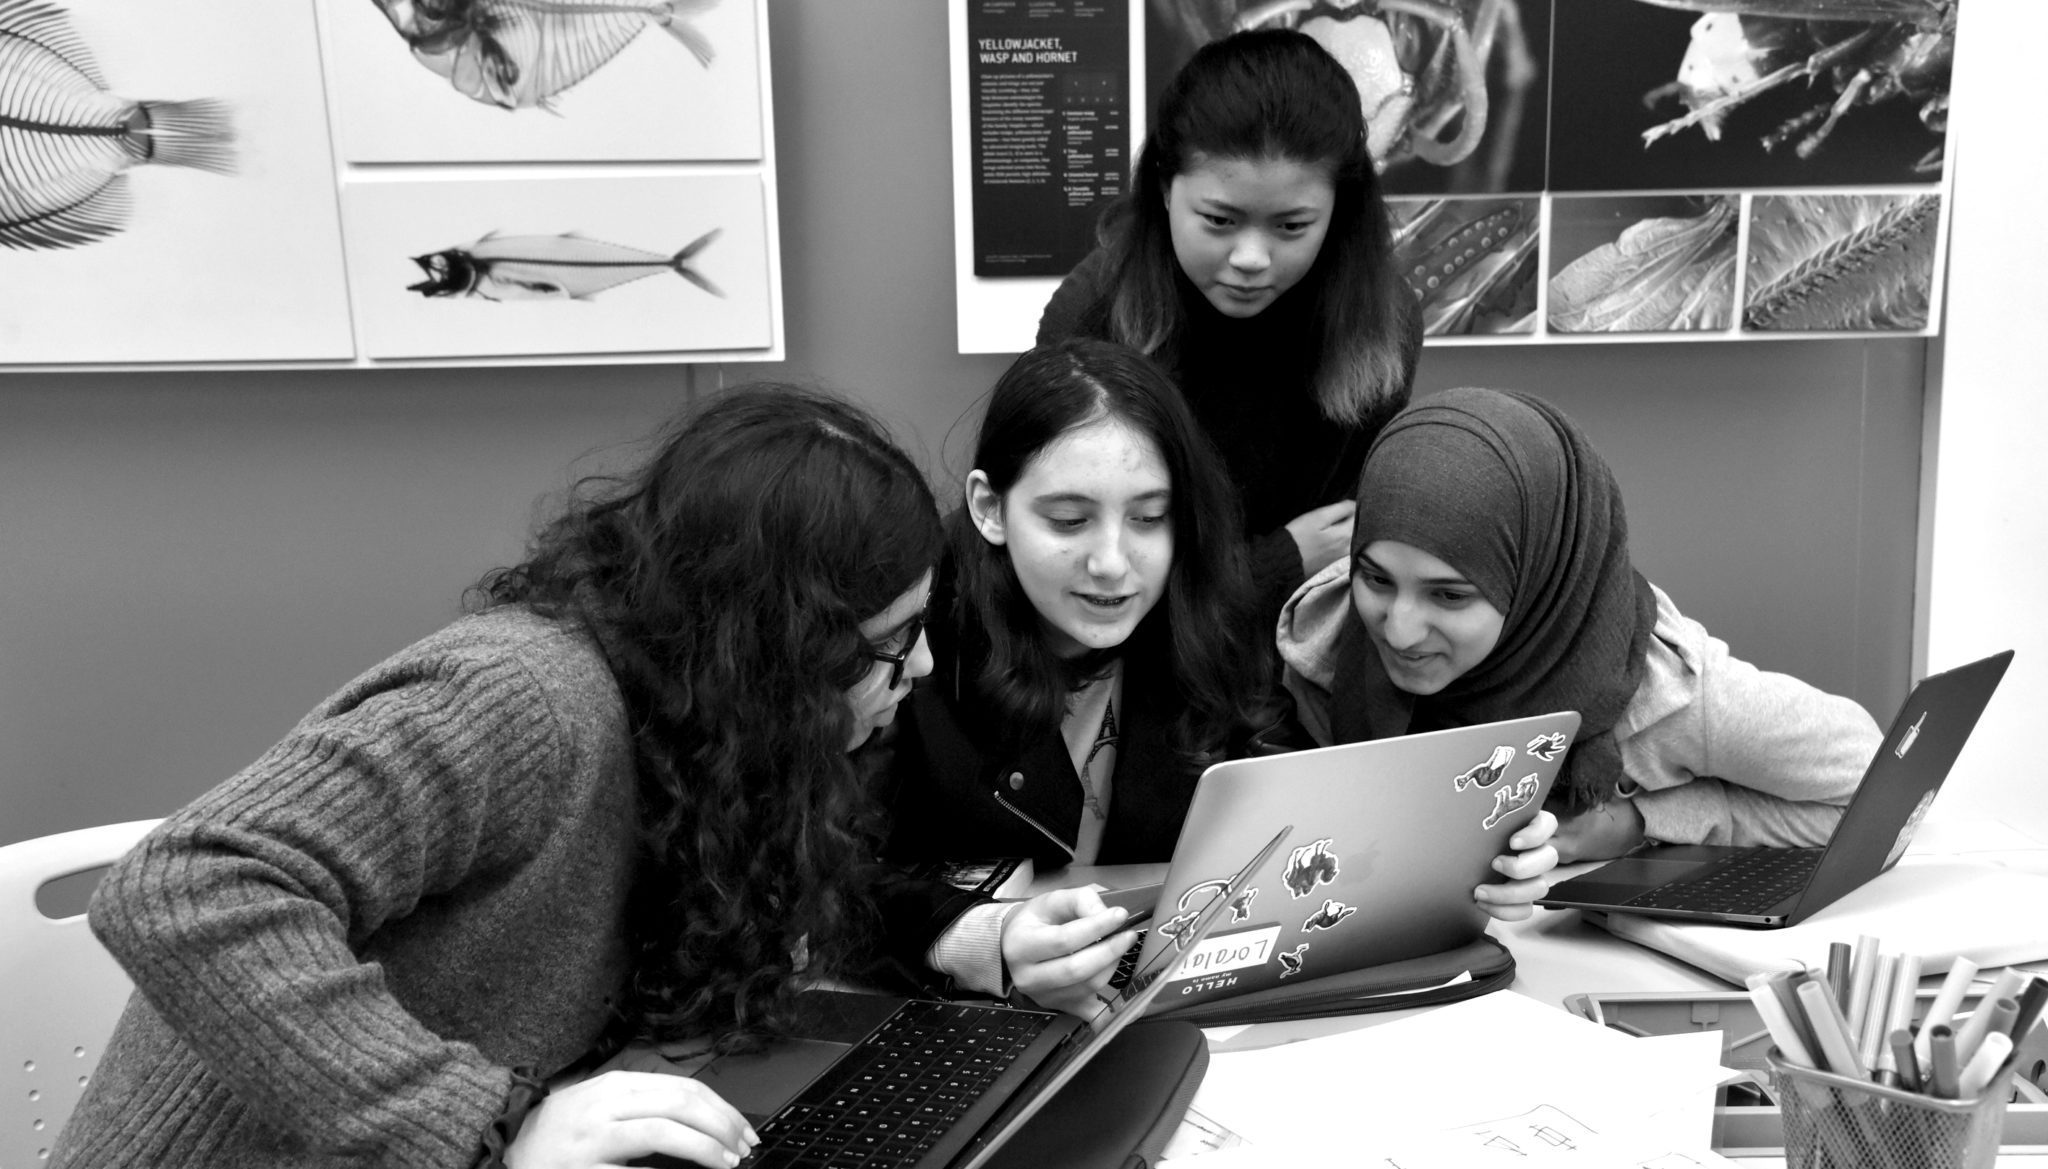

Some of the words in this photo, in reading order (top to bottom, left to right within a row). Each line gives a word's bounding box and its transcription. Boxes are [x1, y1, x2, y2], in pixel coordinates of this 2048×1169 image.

[978, 38, 1062, 50] YELLOWJACKET,
[980, 53, 1009, 63] WASP
[1011, 52, 1033, 63] AND
[1036, 51, 1078, 63] HORNET
[1182, 976, 1238, 995] HELLO
